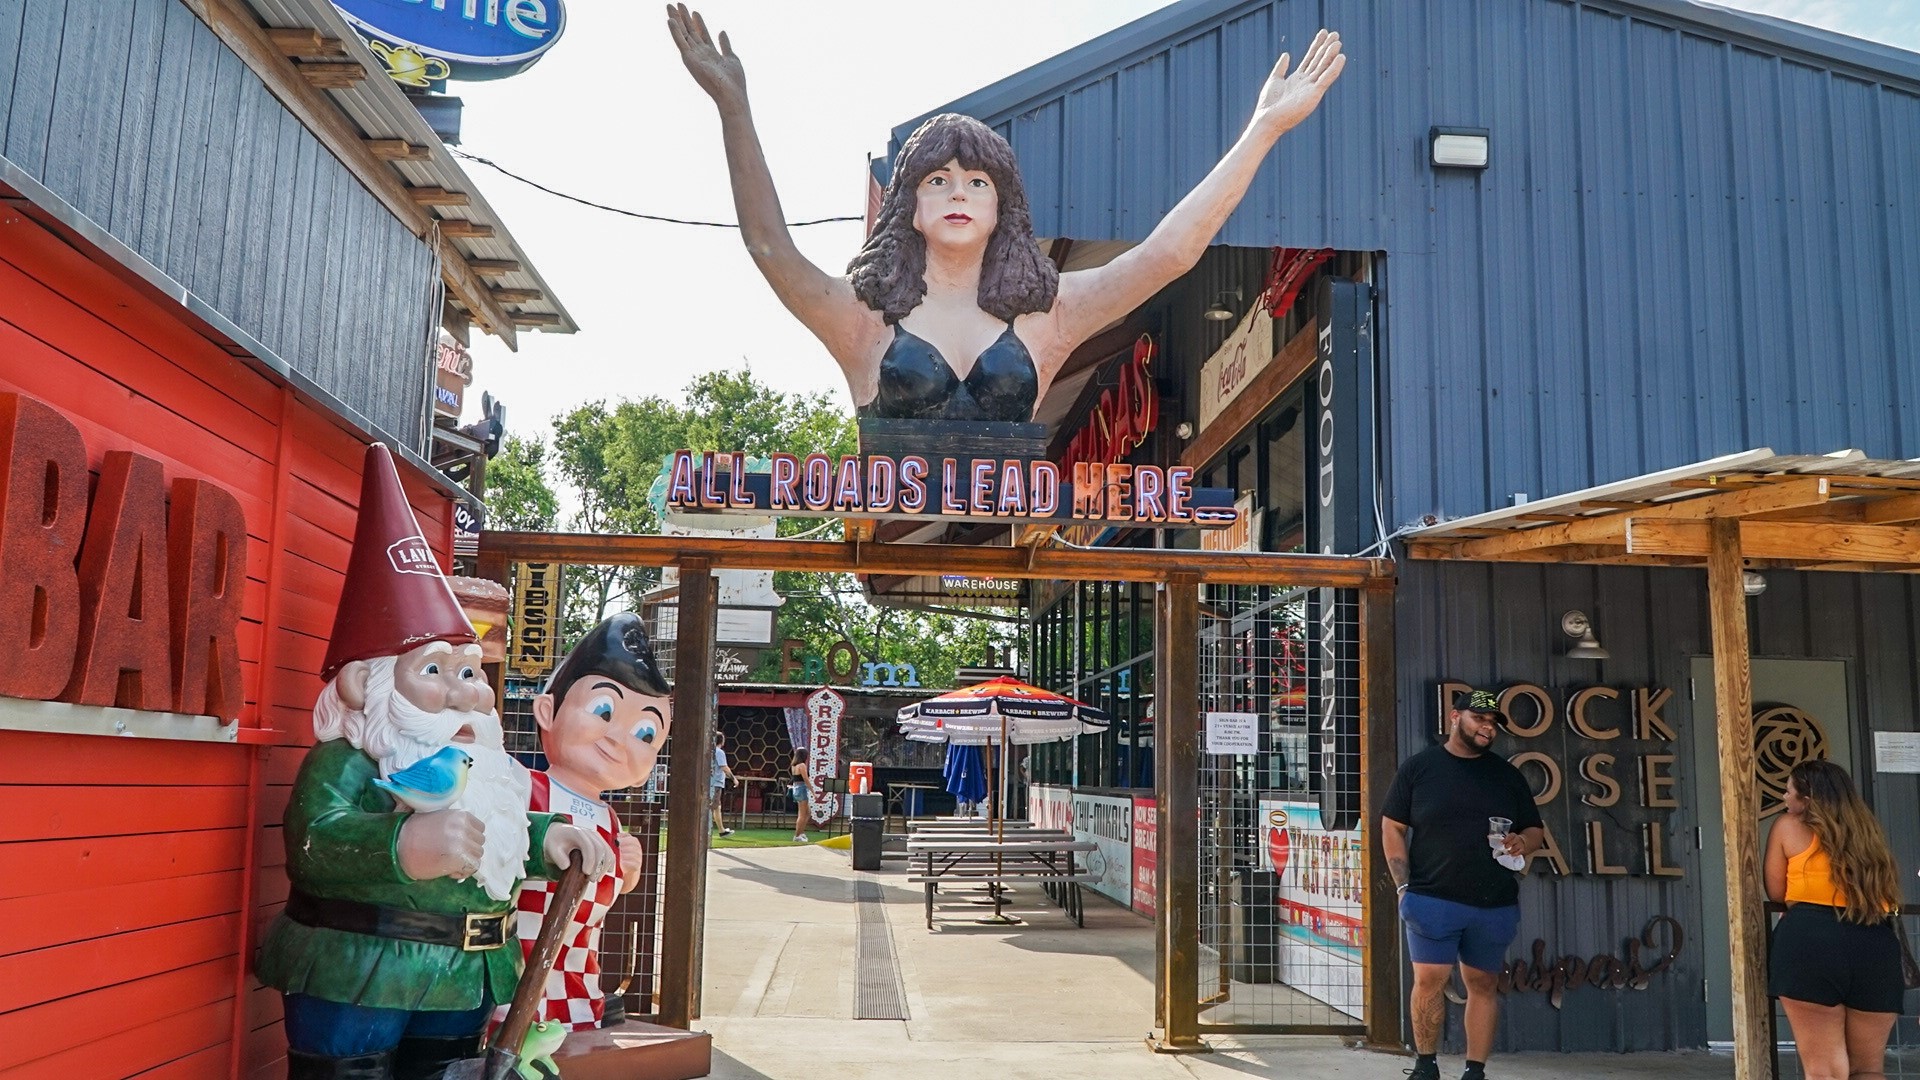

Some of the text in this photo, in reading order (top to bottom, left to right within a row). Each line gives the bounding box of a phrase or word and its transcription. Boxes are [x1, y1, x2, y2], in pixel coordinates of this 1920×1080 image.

[1319, 317, 1334, 507] FOOD
[667, 448, 756, 509] ALL
[770, 452, 929, 514] ROADS
[941, 457, 1061, 518] LEAD
[0, 392, 248, 726] BAR
[943, 578, 1019, 591] WAREHOUSE
[518, 563, 549, 663] IBSON
[570, 805, 595, 819] BOY
[572, 798, 593, 812] BIG
